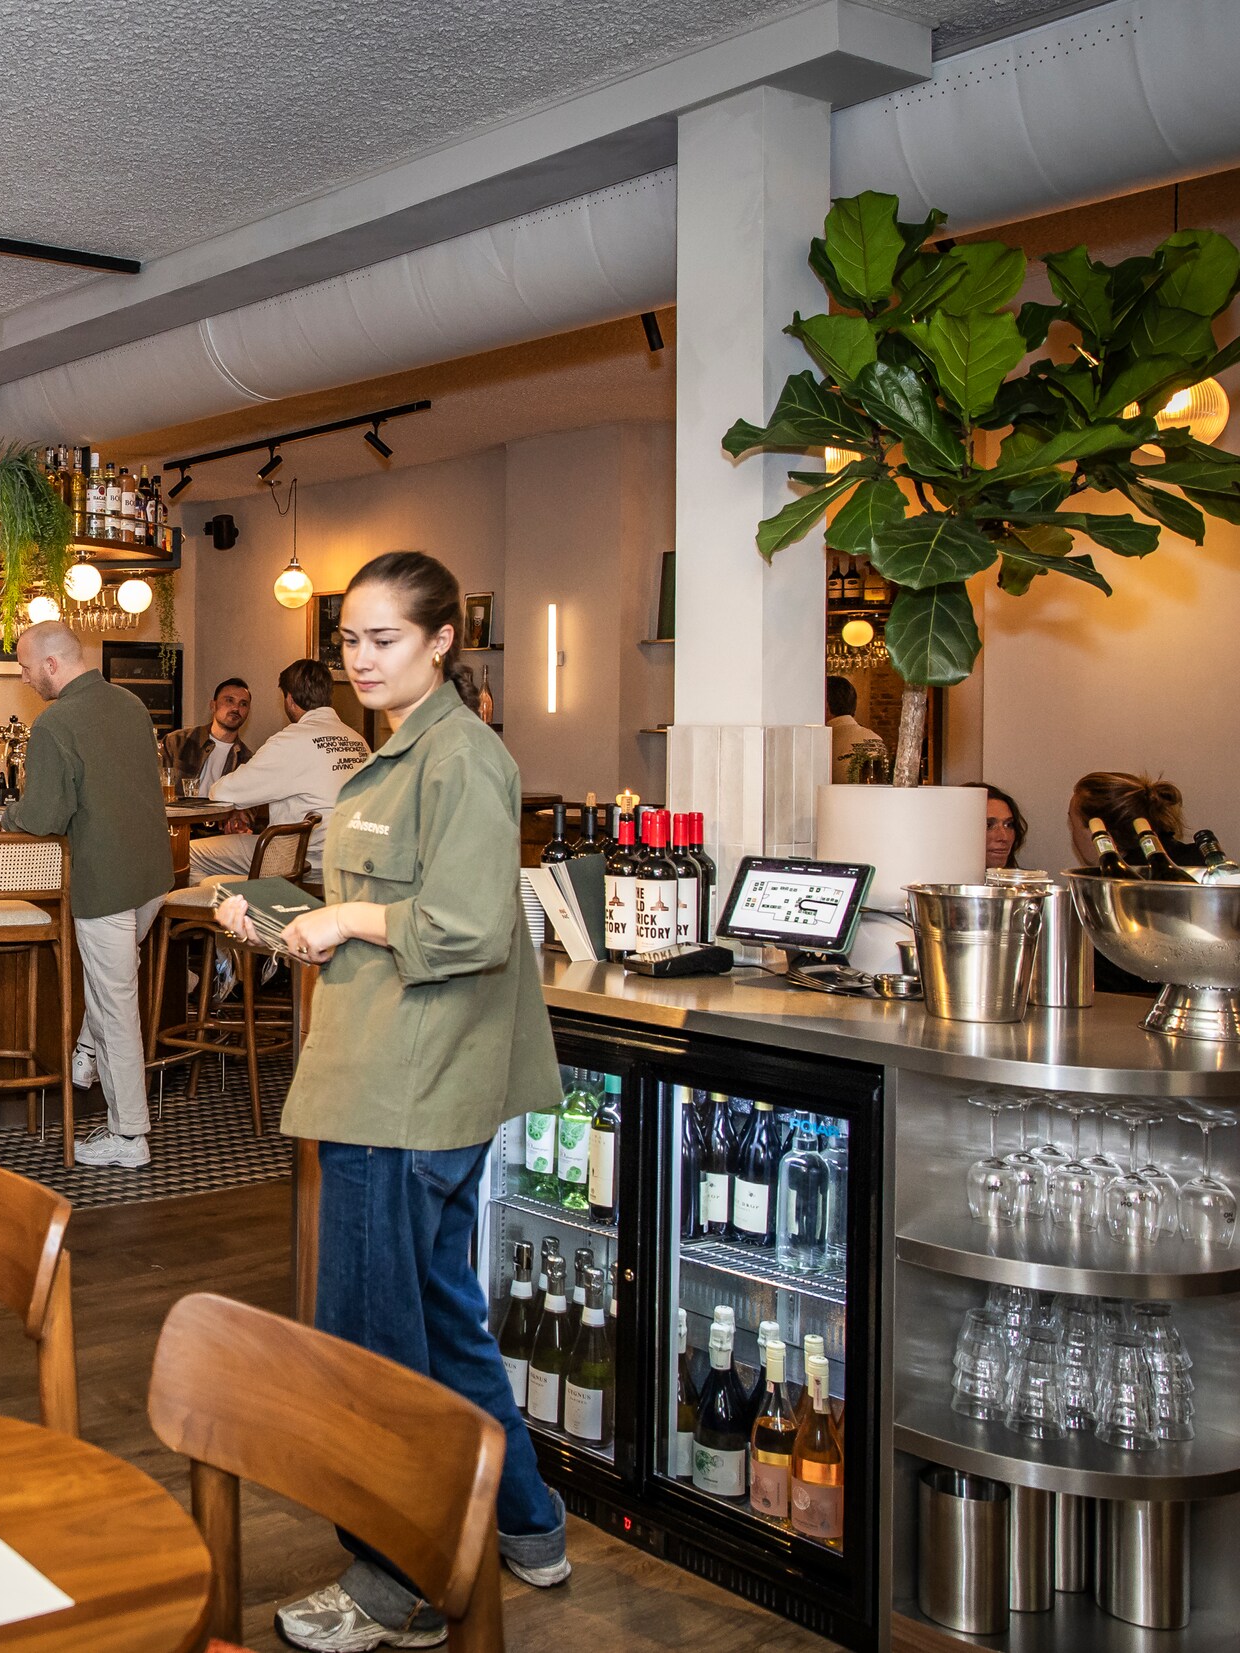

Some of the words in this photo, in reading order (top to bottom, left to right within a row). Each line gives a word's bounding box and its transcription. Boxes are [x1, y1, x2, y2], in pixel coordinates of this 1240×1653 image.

[312, 735, 349, 744] WATERPOLO
[332, 763, 354, 771] DIVING
[789, 1117, 840, 1138] POLAR
